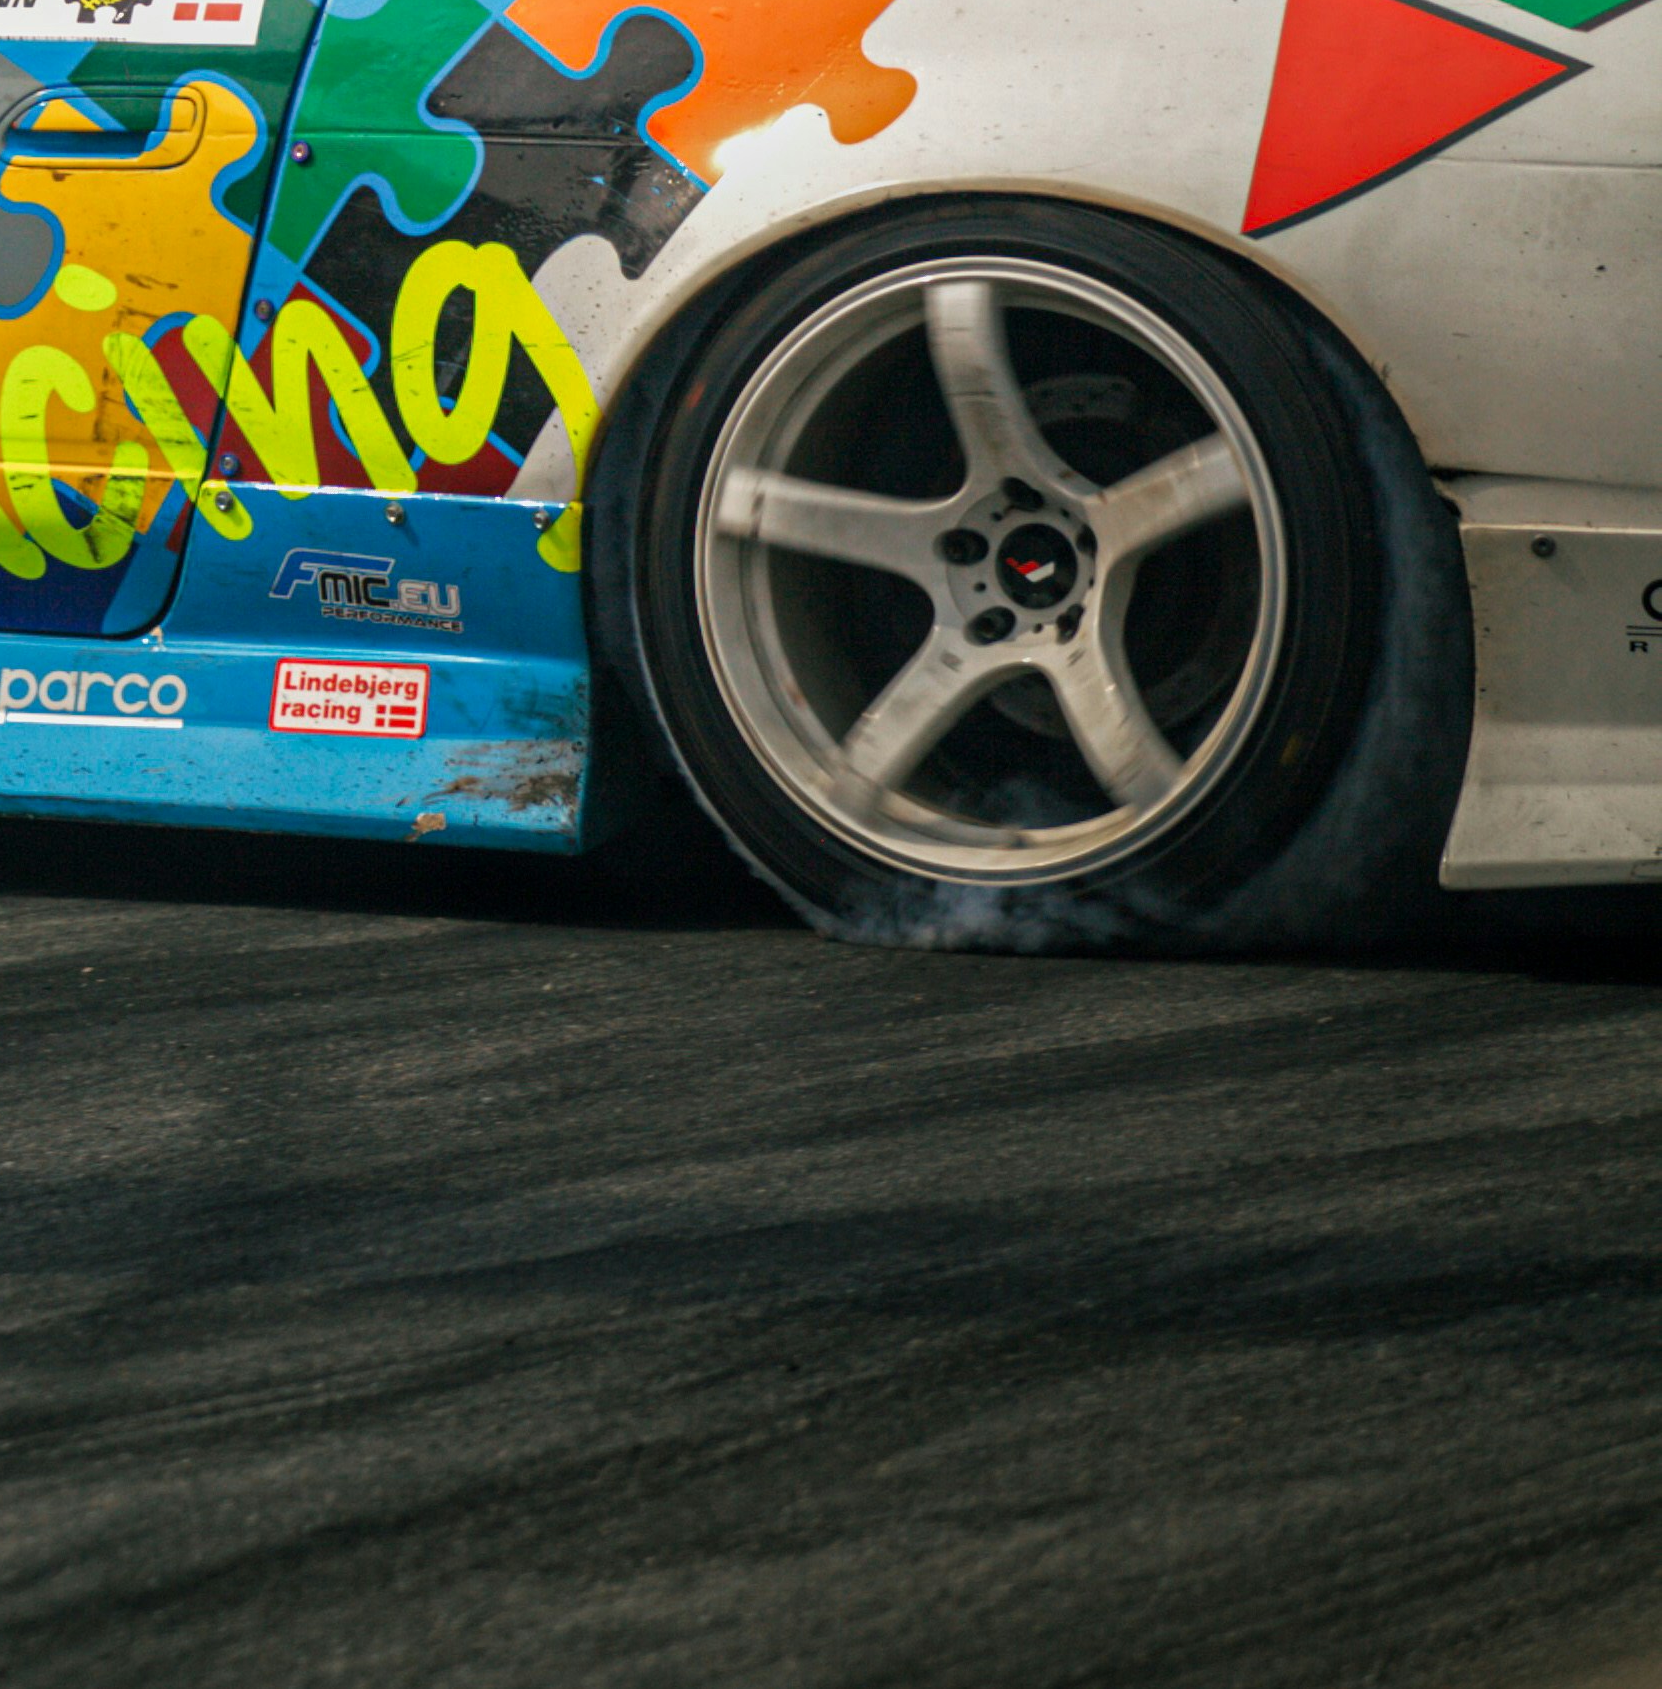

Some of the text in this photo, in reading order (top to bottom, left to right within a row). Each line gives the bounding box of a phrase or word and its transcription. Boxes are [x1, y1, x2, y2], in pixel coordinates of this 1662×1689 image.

[321, 605, 464, 634] PERFORMANCE
[283, 670, 420, 701] Lindebjerg
[280, 699, 362, 725] racing
